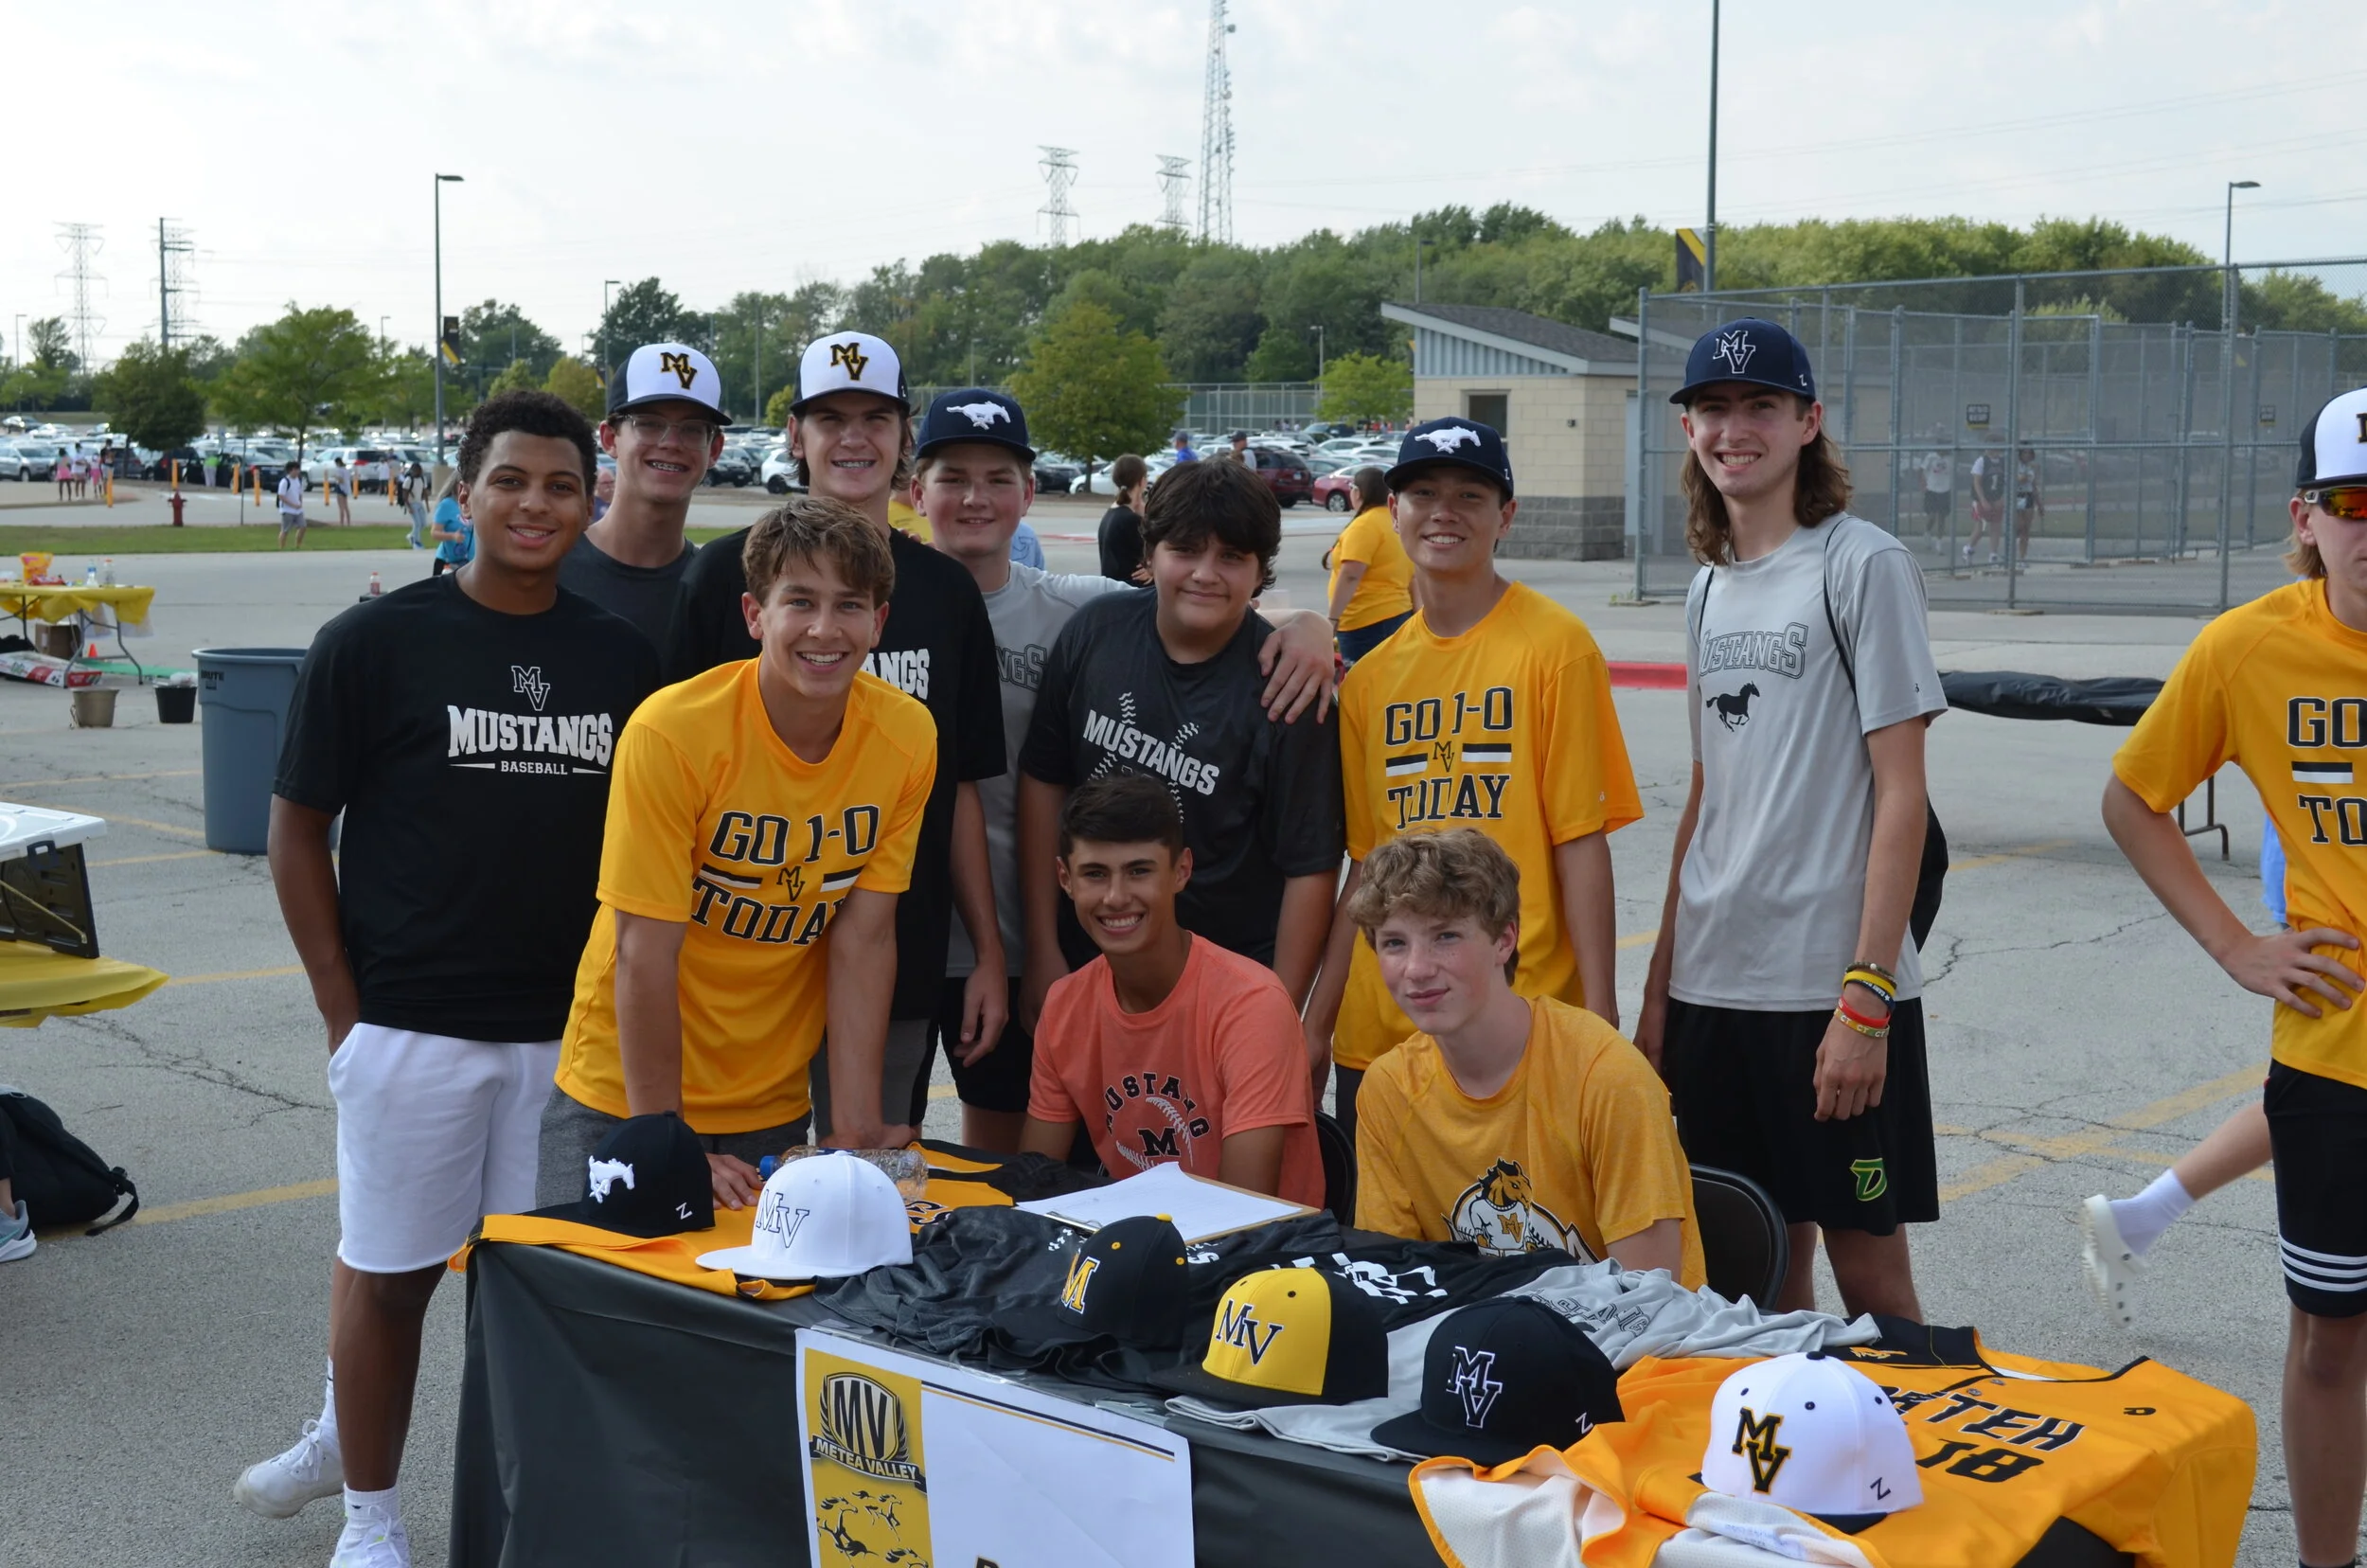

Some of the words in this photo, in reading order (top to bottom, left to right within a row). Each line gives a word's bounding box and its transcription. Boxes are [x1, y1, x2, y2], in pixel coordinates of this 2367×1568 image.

[660, 351, 698, 390] MV
[829, 342, 869, 381] MV
[1712, 330, 1756, 374] MV
[511, 665, 550, 711] MV
[447, 704, 614, 767] MUSTANGS
[1385, 697, 1443, 746] GO
[1450, 686, 1514, 735] 1-0
[2287, 696, 2367, 748] GO
[500, 760, 568, 775] BASEBALL
[1083, 708, 1220, 795] MUSTANGS
[1433, 740, 1455, 773] MV
[1387, 774, 1512, 830] TODAY
[709, 811, 791, 865] GO
[803, 804, 881, 864] 1-0
[776, 865, 806, 902] MV
[1136, 1127, 1182, 1157] M
[675, 1202, 693, 1221] Z
[756, 1188, 810, 1249] MV
[1060, 1249, 1100, 1315] M
[1216, 1298, 1285, 1366] MV
[1446, 1345, 1504, 1429] MV
[834, 1380, 888, 1460] MV
[1575, 1412, 1594, 1434] Z
[816, 1438, 864, 1470] METEA
[865, 1459, 917, 1481] VALLEY
[1731, 1405, 1793, 1495] MV
[1870, 1476, 1891, 1501] Z
